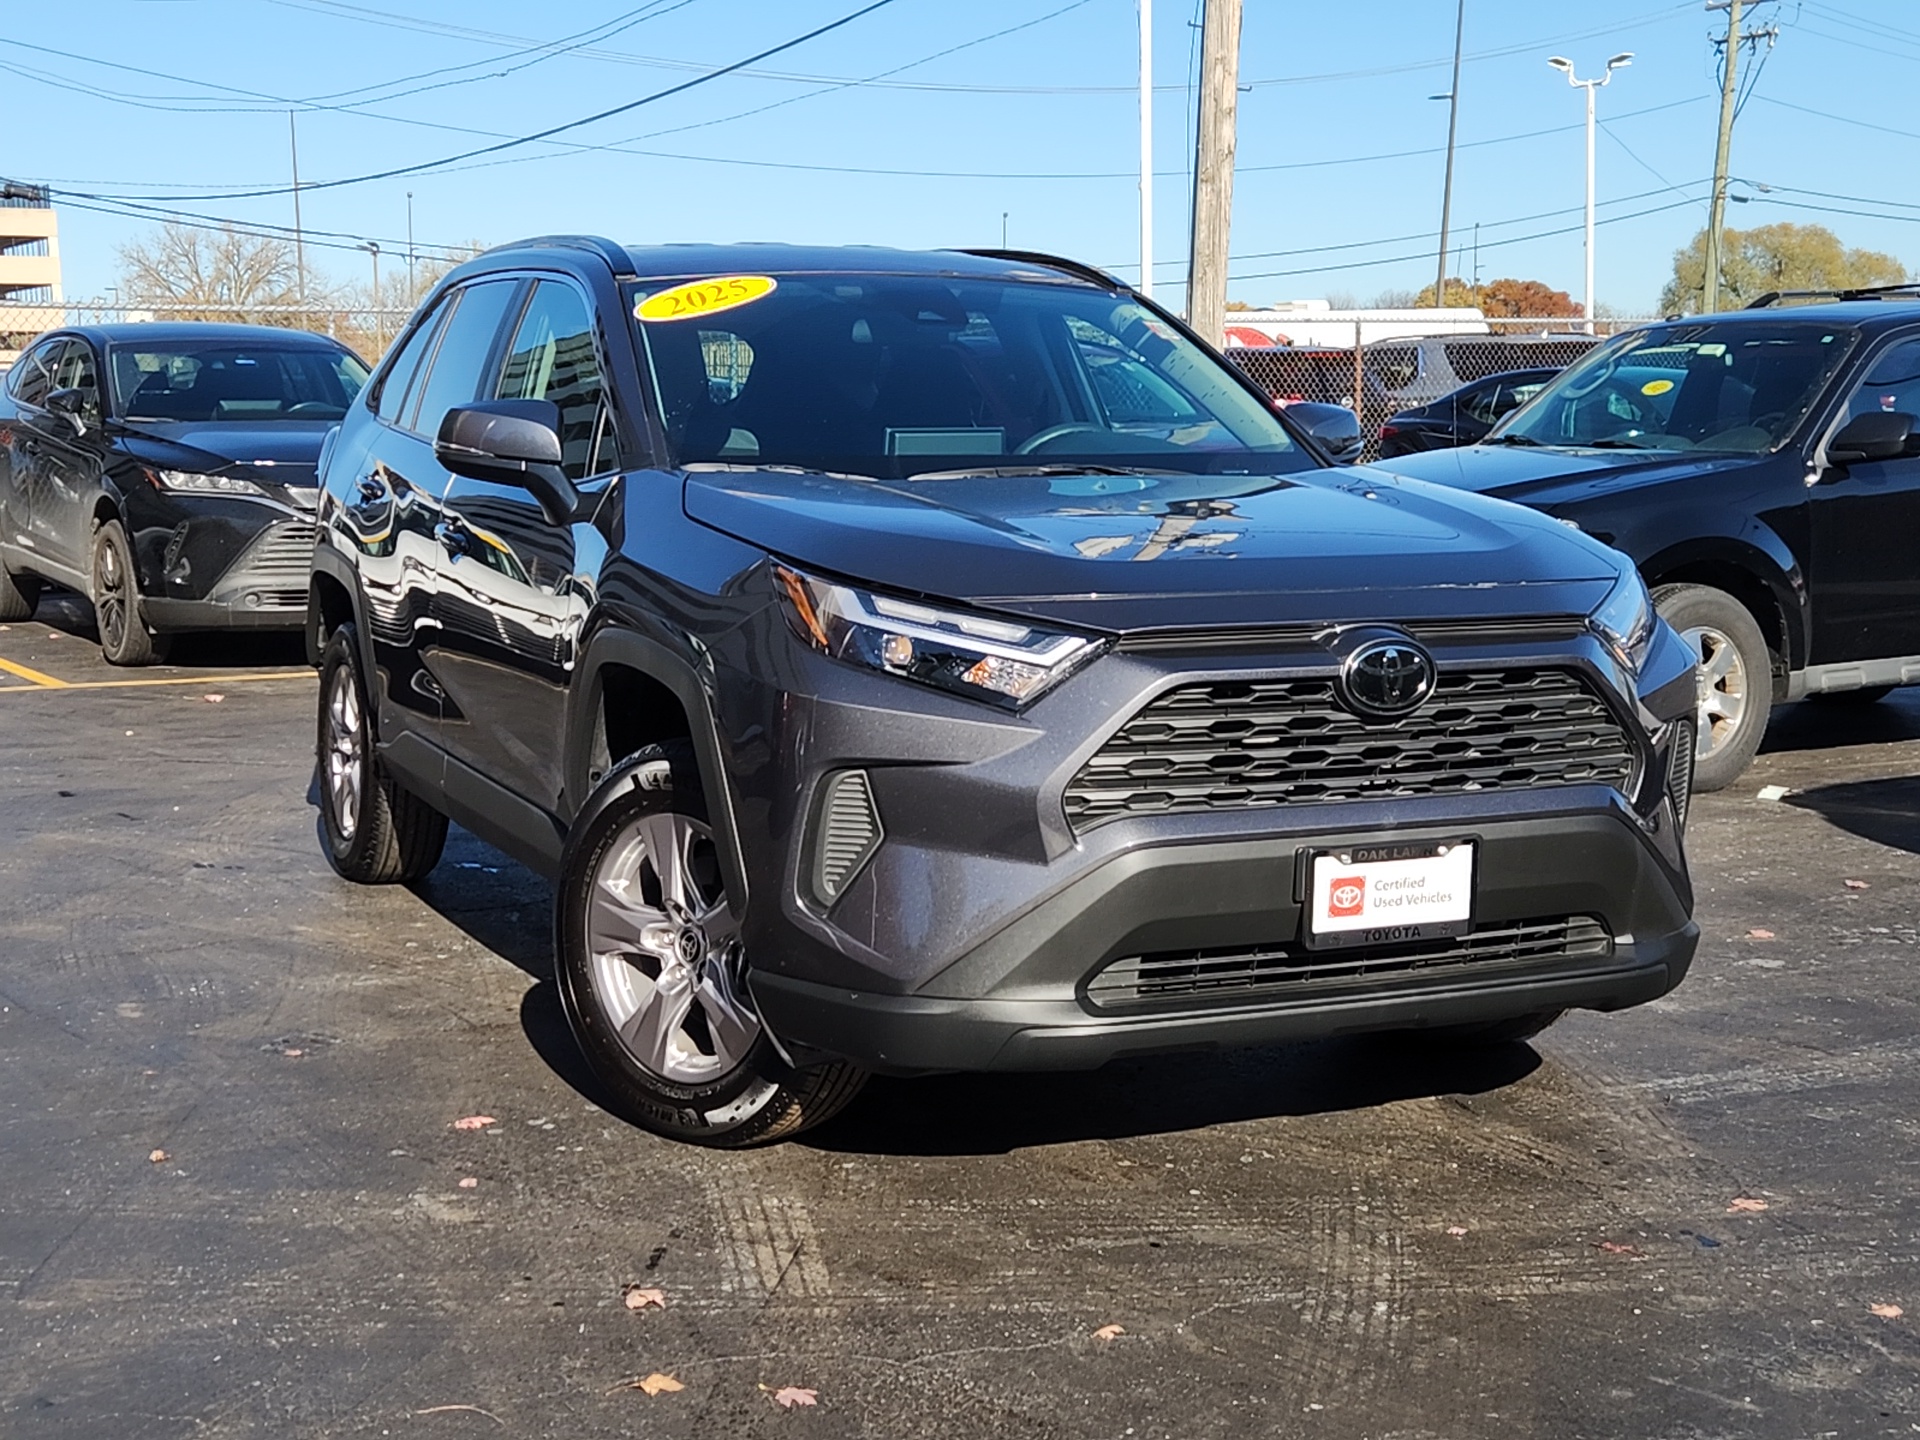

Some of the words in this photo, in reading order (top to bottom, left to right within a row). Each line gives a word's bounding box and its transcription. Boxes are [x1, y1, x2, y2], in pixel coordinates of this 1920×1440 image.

[663, 279, 748, 315] 2025
[1357, 849, 1388, 861] OAK
[1374, 877, 1426, 891] Certified
[1373, 895, 1403, 908] Used
[1406, 891, 1452, 905] Vehicles
[1362, 926, 1421, 942] TOYOTA
